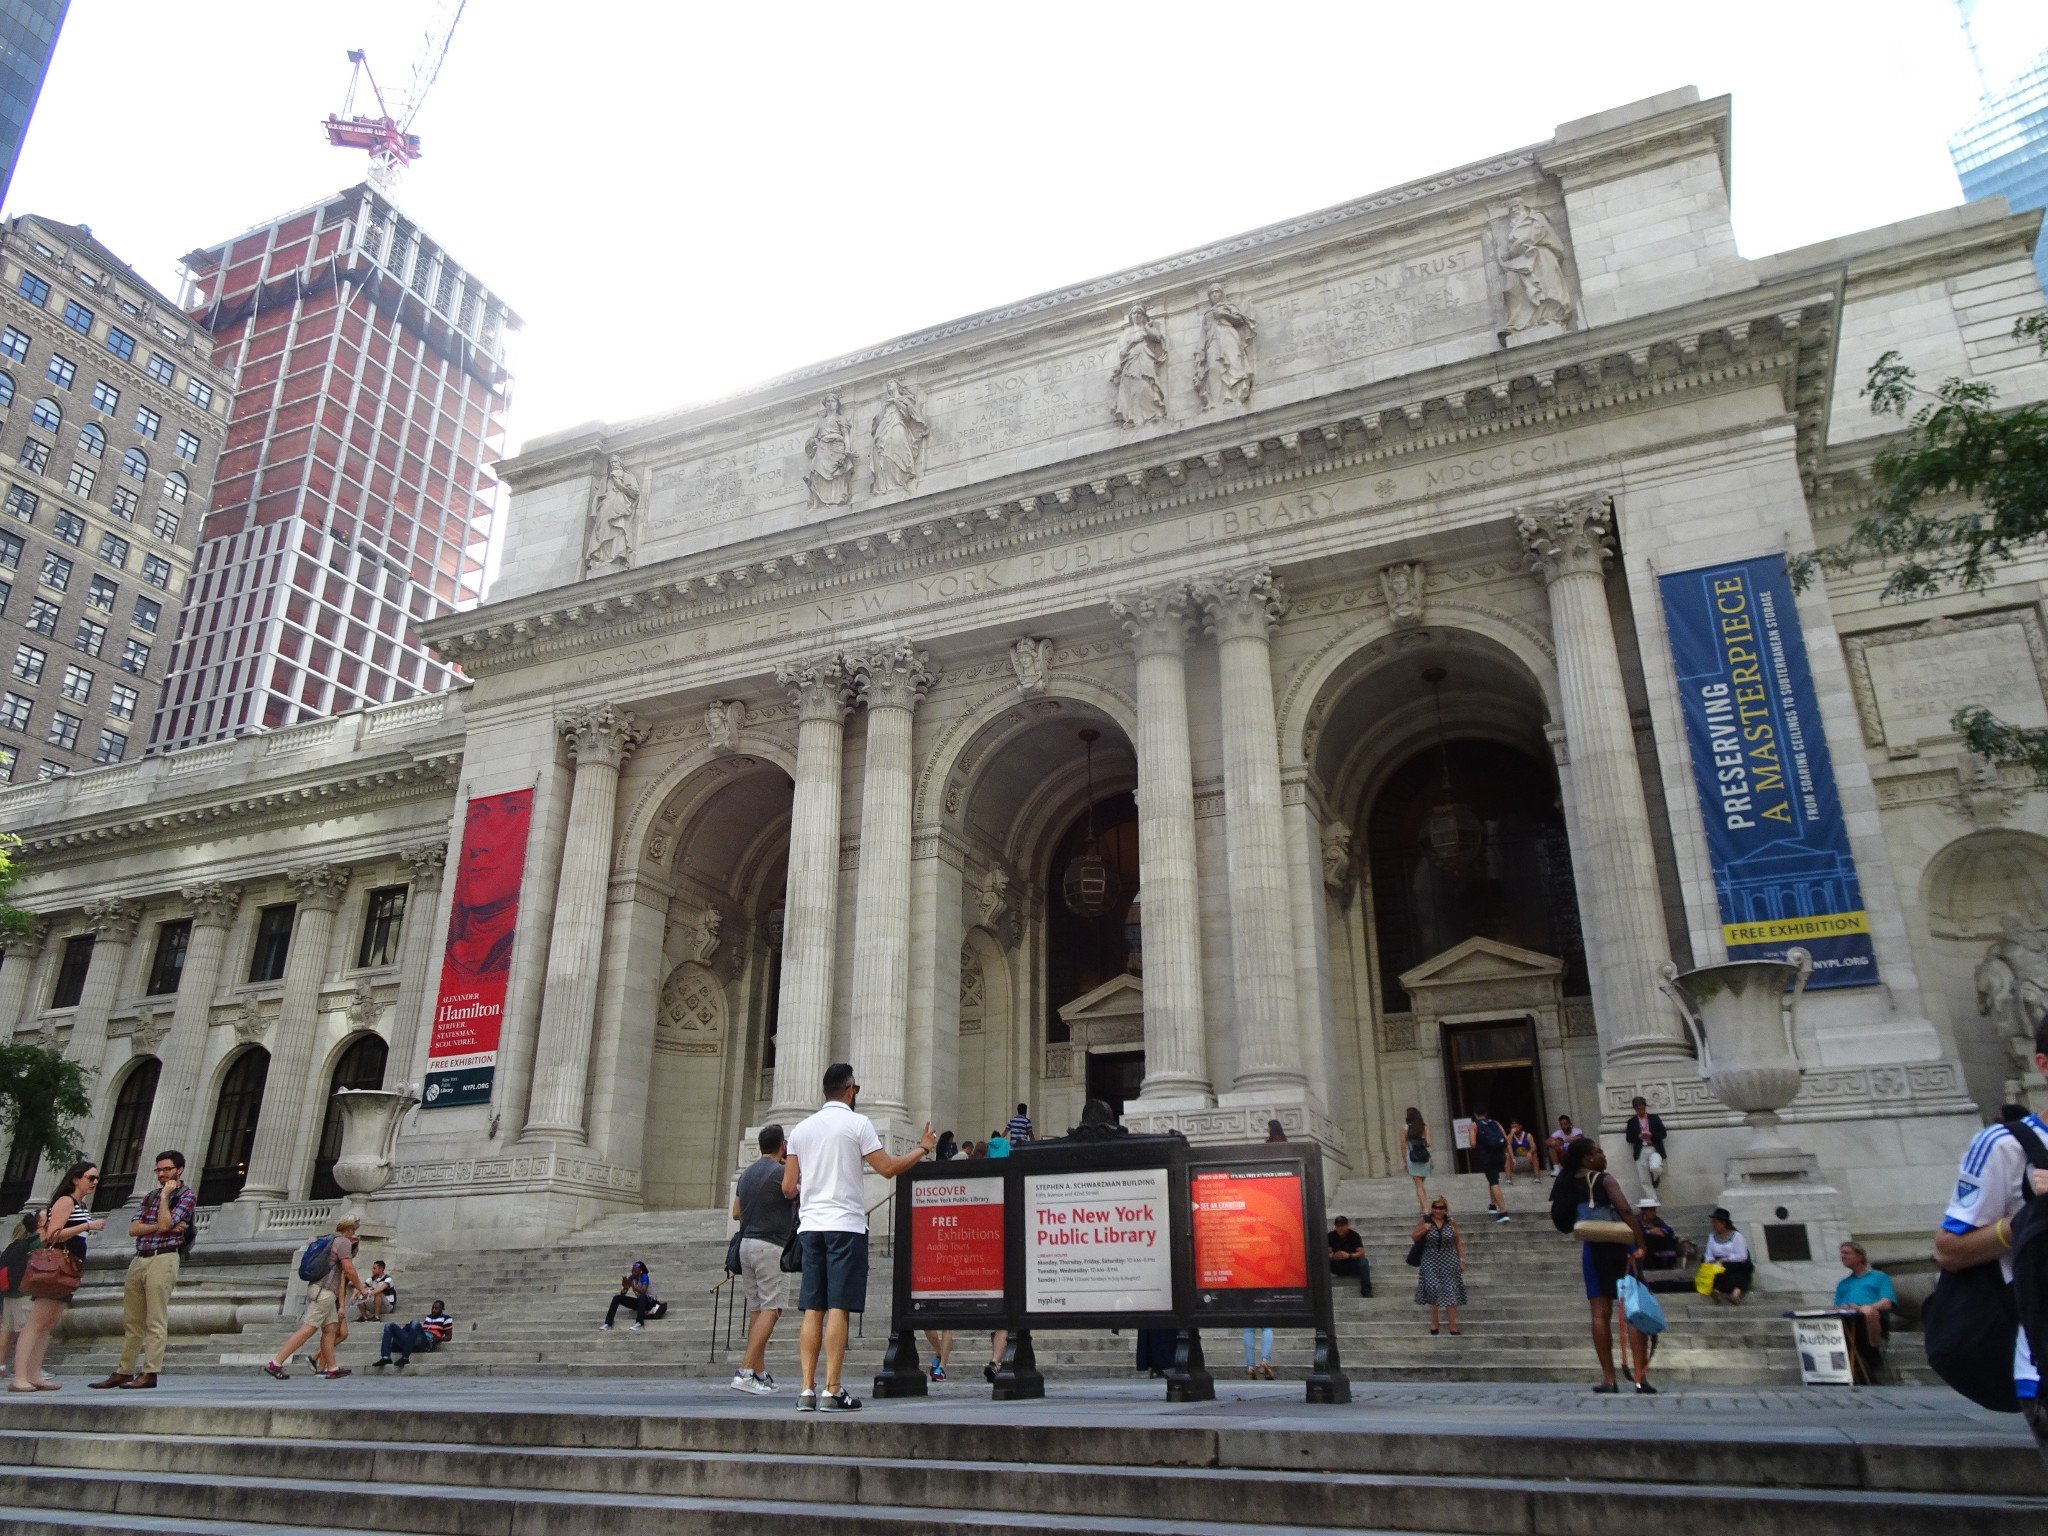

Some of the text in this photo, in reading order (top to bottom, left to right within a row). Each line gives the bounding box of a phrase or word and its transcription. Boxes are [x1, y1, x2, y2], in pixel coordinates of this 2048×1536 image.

[1264, 249, 1470, 321] THE TILDEN TRUST
[1326, 288, 1407, 317] FOUNDED BY
[1347, 302, 1395, 324] JONES
[1402, 286, 1452, 309] TILDEN
[1345, 322, 1365, 335] THE
[937, 351, 1107, 410] THE LENOX LIBRARY
[1044, 384, 1054, 394] BY
[972, 391, 1068, 425] JAMES LENOX
[956, 418, 1010, 438] DEDICATED
[695, 454, 737, 476] ASTOR
[743, 436, 801, 463] LIBRARY
[748, 468, 781, 484] ASTOR
[733, 611, 792, 642] THE
[813, 589, 892, 626] NEW
[917, 565, 1001, 601] YORK
[1029, 532, 1150, 579] PUBLIC
[1184, 486, 1342, 544] LIBRARY
[1426, 439, 1571, 487] MDCCCCII
[1714, 577, 1792, 824] A MASTERPIECE
[1760, 591, 1820, 821] FROM SOARING CEILINGS TO SUBTERRANEAN STORAGE
[1702, 683, 1756, 830] PRESERVING
[1731, 917, 1860, 940] FREE EXHIBITION
[1812, 956, 1869, 969] NYPL.ORG
[443, 993, 480, 1003] ALEXANDER
[439, 1002, 500, 1022] Hamilton
[438, 1022, 467, 1031] STRIVER.
[437, 1029, 476, 1039] STATESMAN.
[435, 1038, 478, 1048] SCOUNDREL.
[430, 1055, 493, 1069] FREE EXHIBITION
[462, 1082, 490, 1091] NYPL.ORG
[915, 1186, 966, 1197] DISCOVER
[1036, 1183, 1064, 1191] STEPHEN
[1073, 1181, 1121, 1189] SCHWARZMAN
[1122, 1179, 1156, 1187] BUILDING
[932, 1216, 958, 1227] FREE
[1036, 1204, 1154, 1225] The New York
[938, 1227, 1000, 1241] Exhibitions
[1037, 1226, 1156, 1247] Public Library
[927, 1242, 970, 1251] Audio Tours
[936, 1252, 984, 1266] Programs
[955, 1267, 1000, 1275] Guided Tours
[1037, 1296, 1066, 1306] nypl.org
[1799, 1333, 1843, 1345] Author
